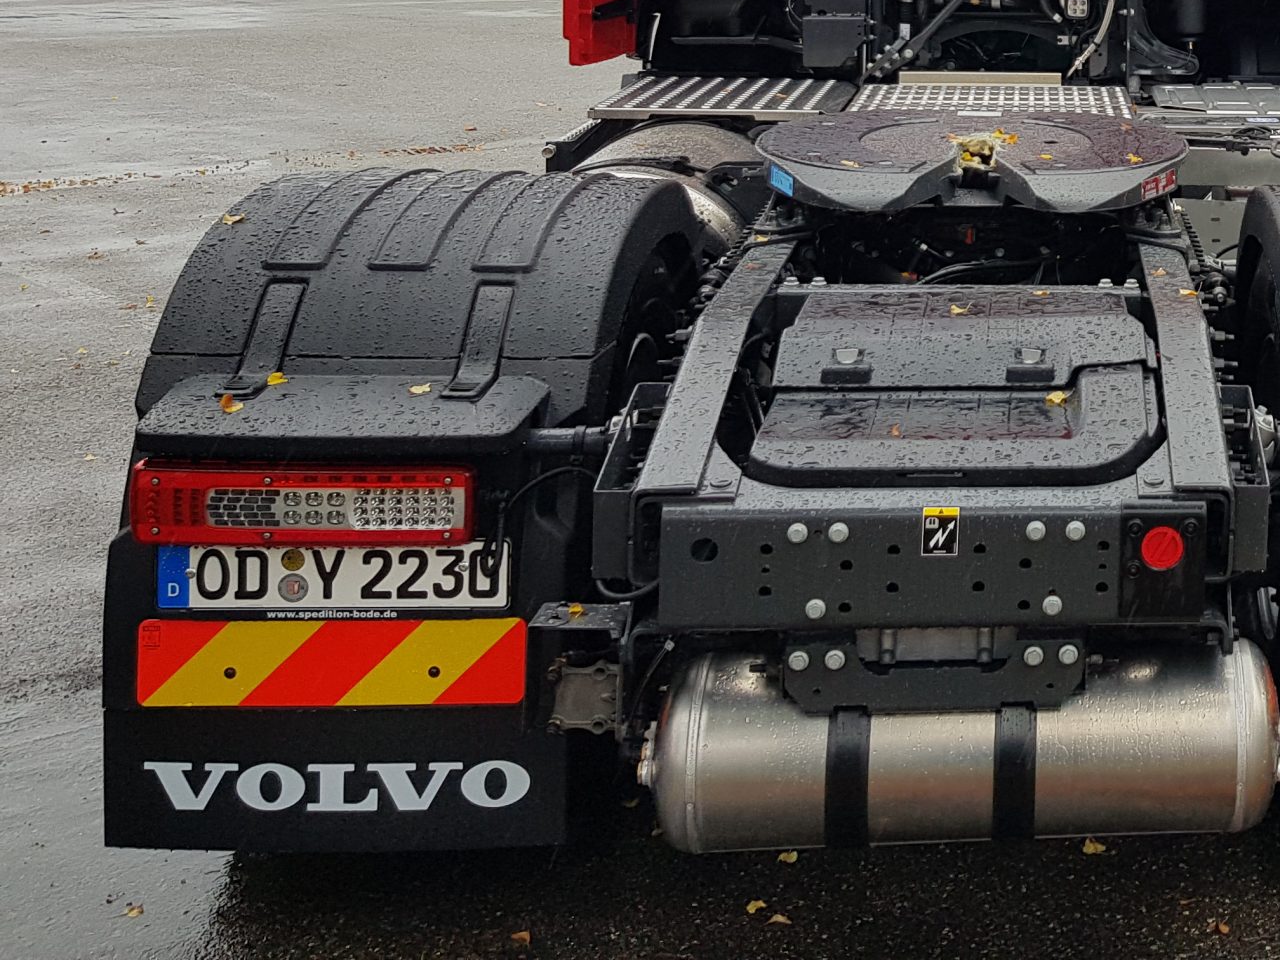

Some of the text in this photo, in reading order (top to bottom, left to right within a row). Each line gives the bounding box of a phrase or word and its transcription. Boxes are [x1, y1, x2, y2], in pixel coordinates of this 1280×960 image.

[167, 582, 180, 597] D
[196, 548, 270, 601] OD
[312, 549, 346, 600] Y
[266, 609, 398, 620] www.spedition-bode.de
[143, 760, 531, 812] VOLVO
